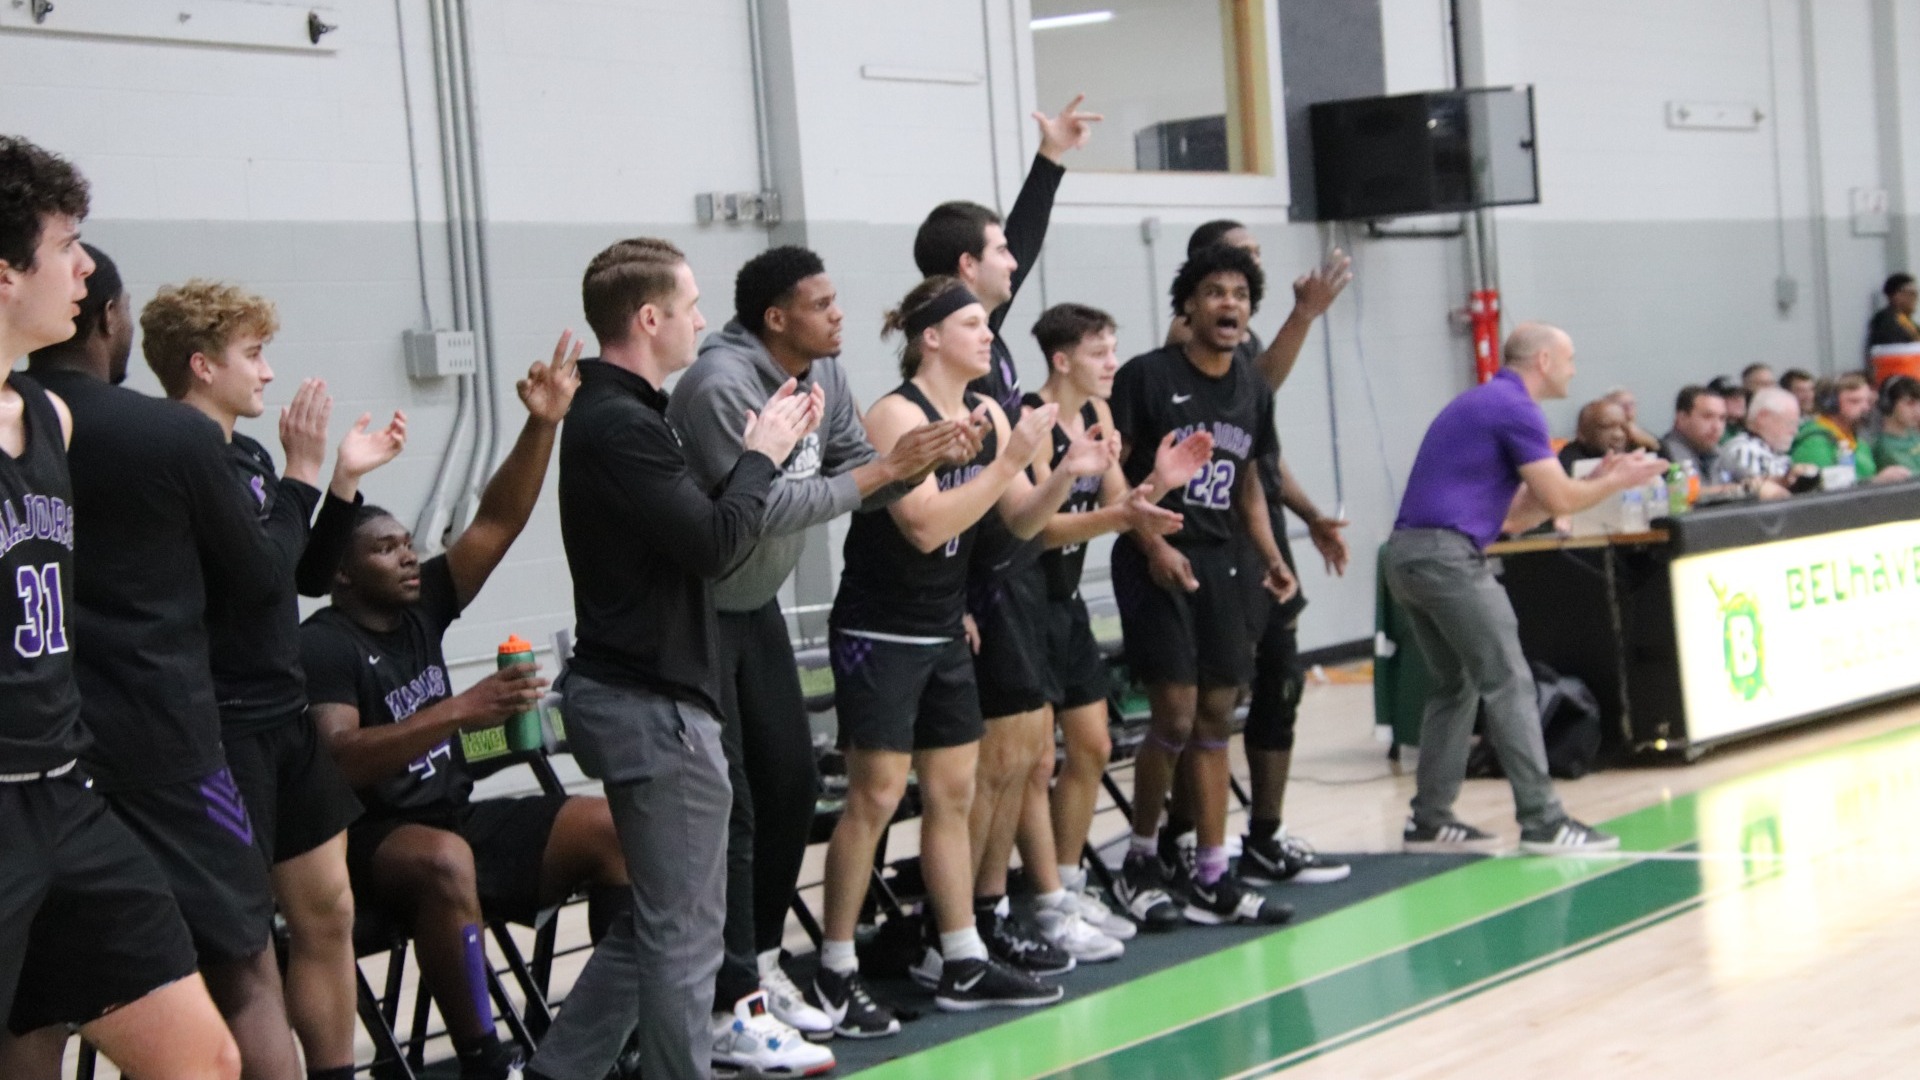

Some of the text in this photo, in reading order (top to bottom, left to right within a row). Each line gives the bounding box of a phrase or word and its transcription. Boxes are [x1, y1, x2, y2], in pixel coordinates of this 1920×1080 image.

[1183, 459, 1236, 511] 22
[0, 493, 74, 558] AJORS
[14, 562, 70, 659] 31
[1729, 614, 1759, 679] B
